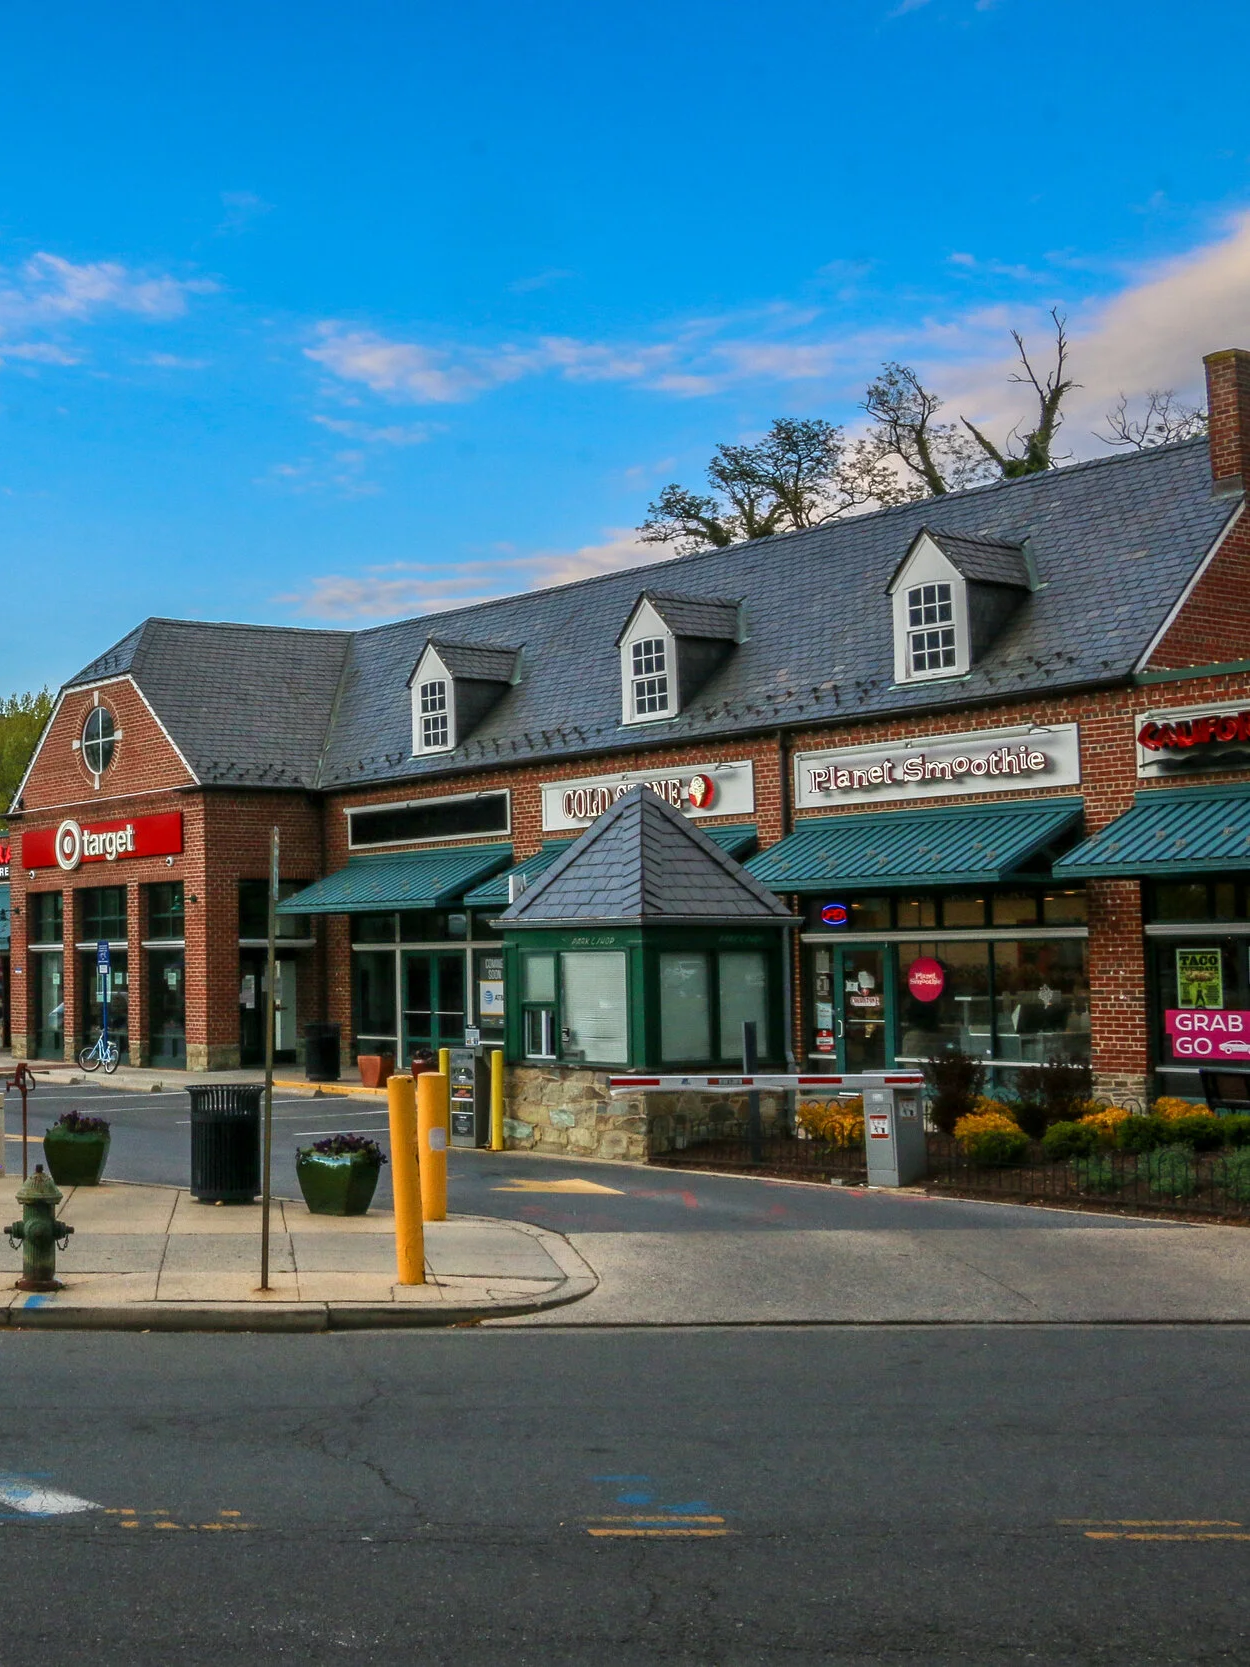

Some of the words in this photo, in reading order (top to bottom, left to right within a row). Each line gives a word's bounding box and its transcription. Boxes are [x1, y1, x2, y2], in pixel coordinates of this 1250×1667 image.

[809, 759, 893, 794] Planet
[903, 745, 1046, 783] Smoothie
[562, 786, 612, 819] COLD
[82, 823, 135, 861] target
[0, 866, 9, 877] RE
[1179, 955, 1218, 966] TACO
[1175, 1013, 1244, 1032] GRAB
[1175, 1036, 1213, 1055] GO
